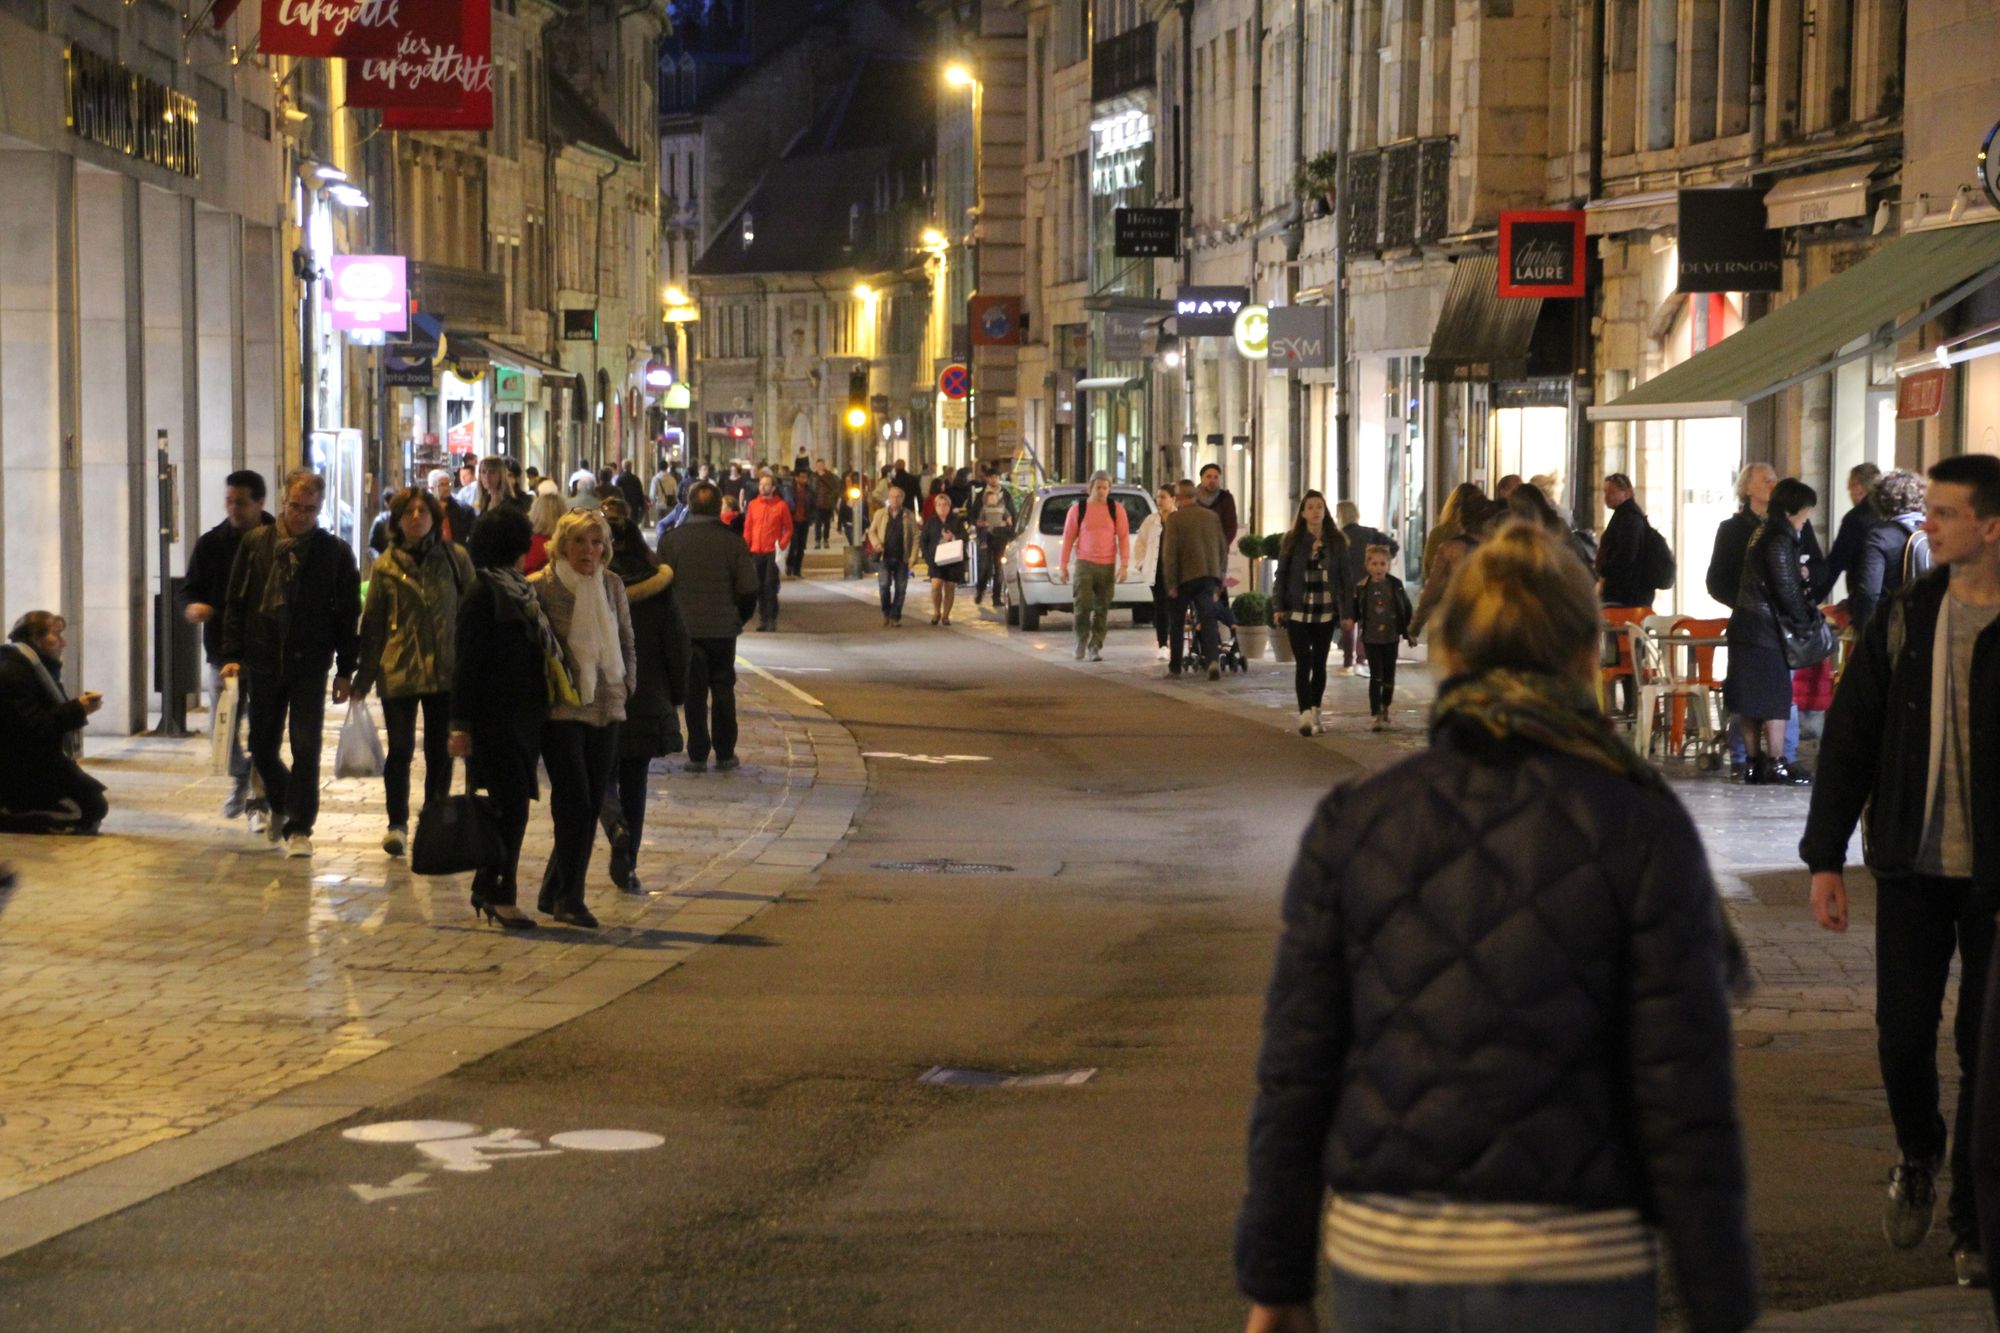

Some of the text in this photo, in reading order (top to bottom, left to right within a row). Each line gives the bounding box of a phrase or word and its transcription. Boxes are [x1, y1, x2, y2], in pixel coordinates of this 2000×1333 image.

[279, 0, 399, 36] Lafayette
[362, 44, 463, 89] Lafayette
[1515, 266, 1564, 280] LAURE
[1681, 260, 1779, 274] DEVERNOIS
[1177, 300, 1242, 315] MATY
[1271, 336, 1321, 362] SYM
[407, 373, 430, 382] 2000
